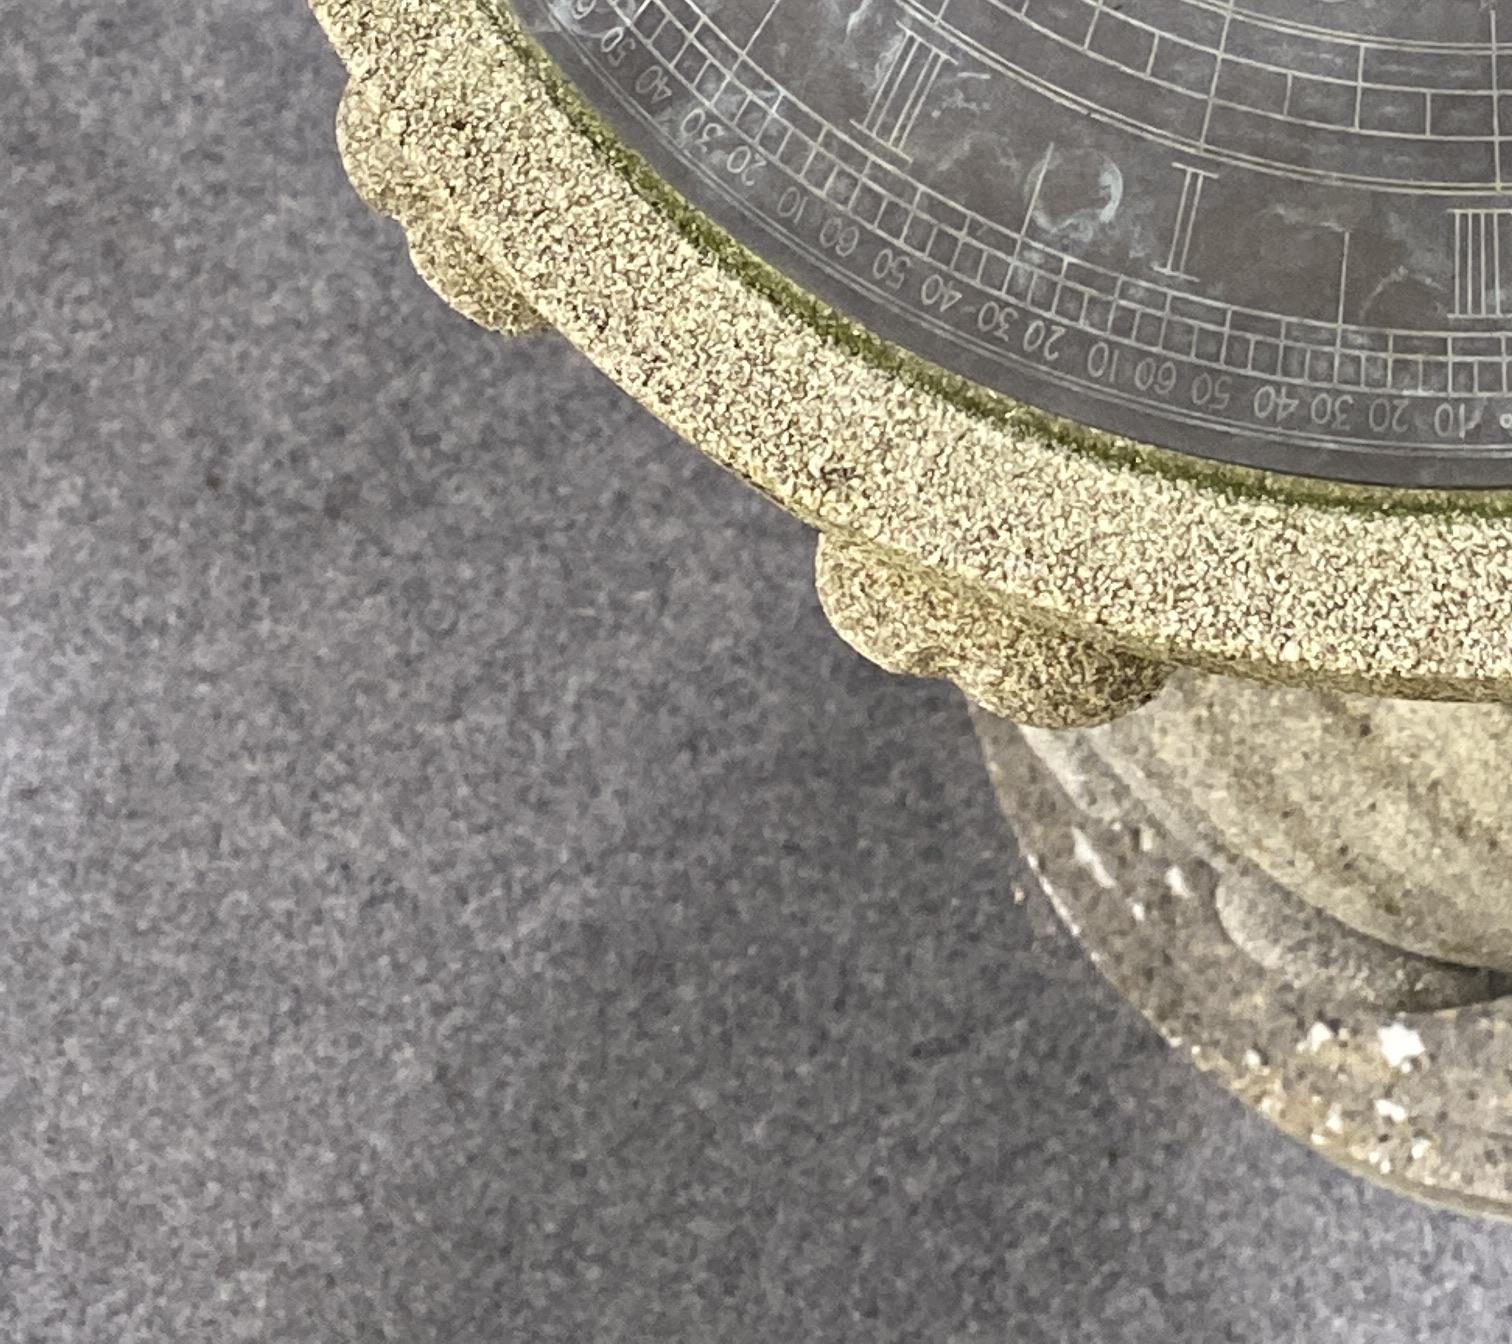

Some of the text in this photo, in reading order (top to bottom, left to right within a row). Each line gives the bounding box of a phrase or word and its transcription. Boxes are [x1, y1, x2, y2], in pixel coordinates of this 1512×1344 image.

[600, 24, 633, 62] 50
[636, 64, 672, 106] 40
[849, 20, 959, 161] II
[681, 106, 720, 150] 30
[727, 143, 764, 185] 20
[777, 185, 807, 222] 10
[1148, 162, 1218, 281] I
[820, 214, 1119, 380] 10 20 30 40 50 60
[1135, 356, 1466, 437] 10 20 30 40 50 60
